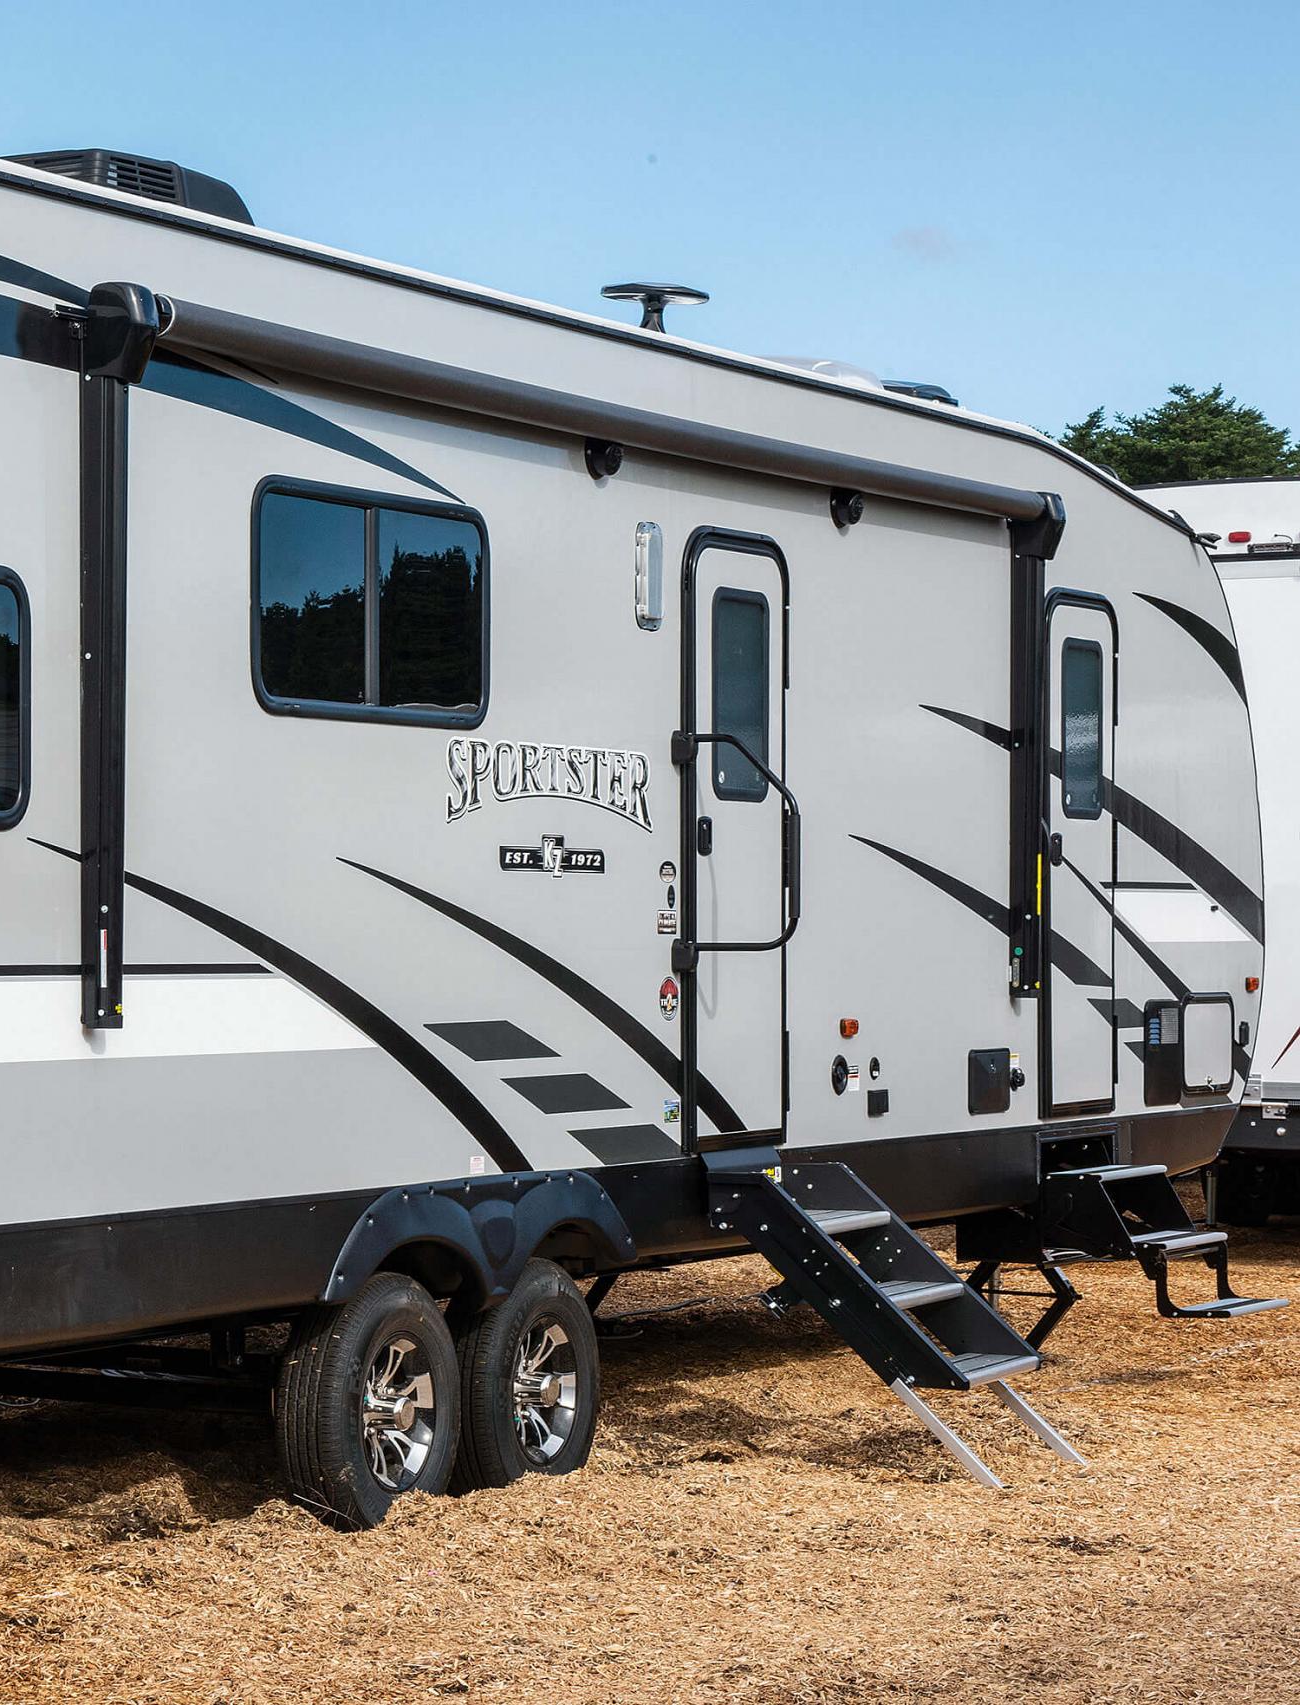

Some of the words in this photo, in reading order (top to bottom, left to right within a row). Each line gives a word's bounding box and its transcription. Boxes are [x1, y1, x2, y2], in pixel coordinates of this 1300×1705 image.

[446, 737, 653, 833] SPORTSTER
[504, 851, 534, 865] EST.
[543, 838, 565, 878] KZ
[570, 853, 602, 867] 1972
